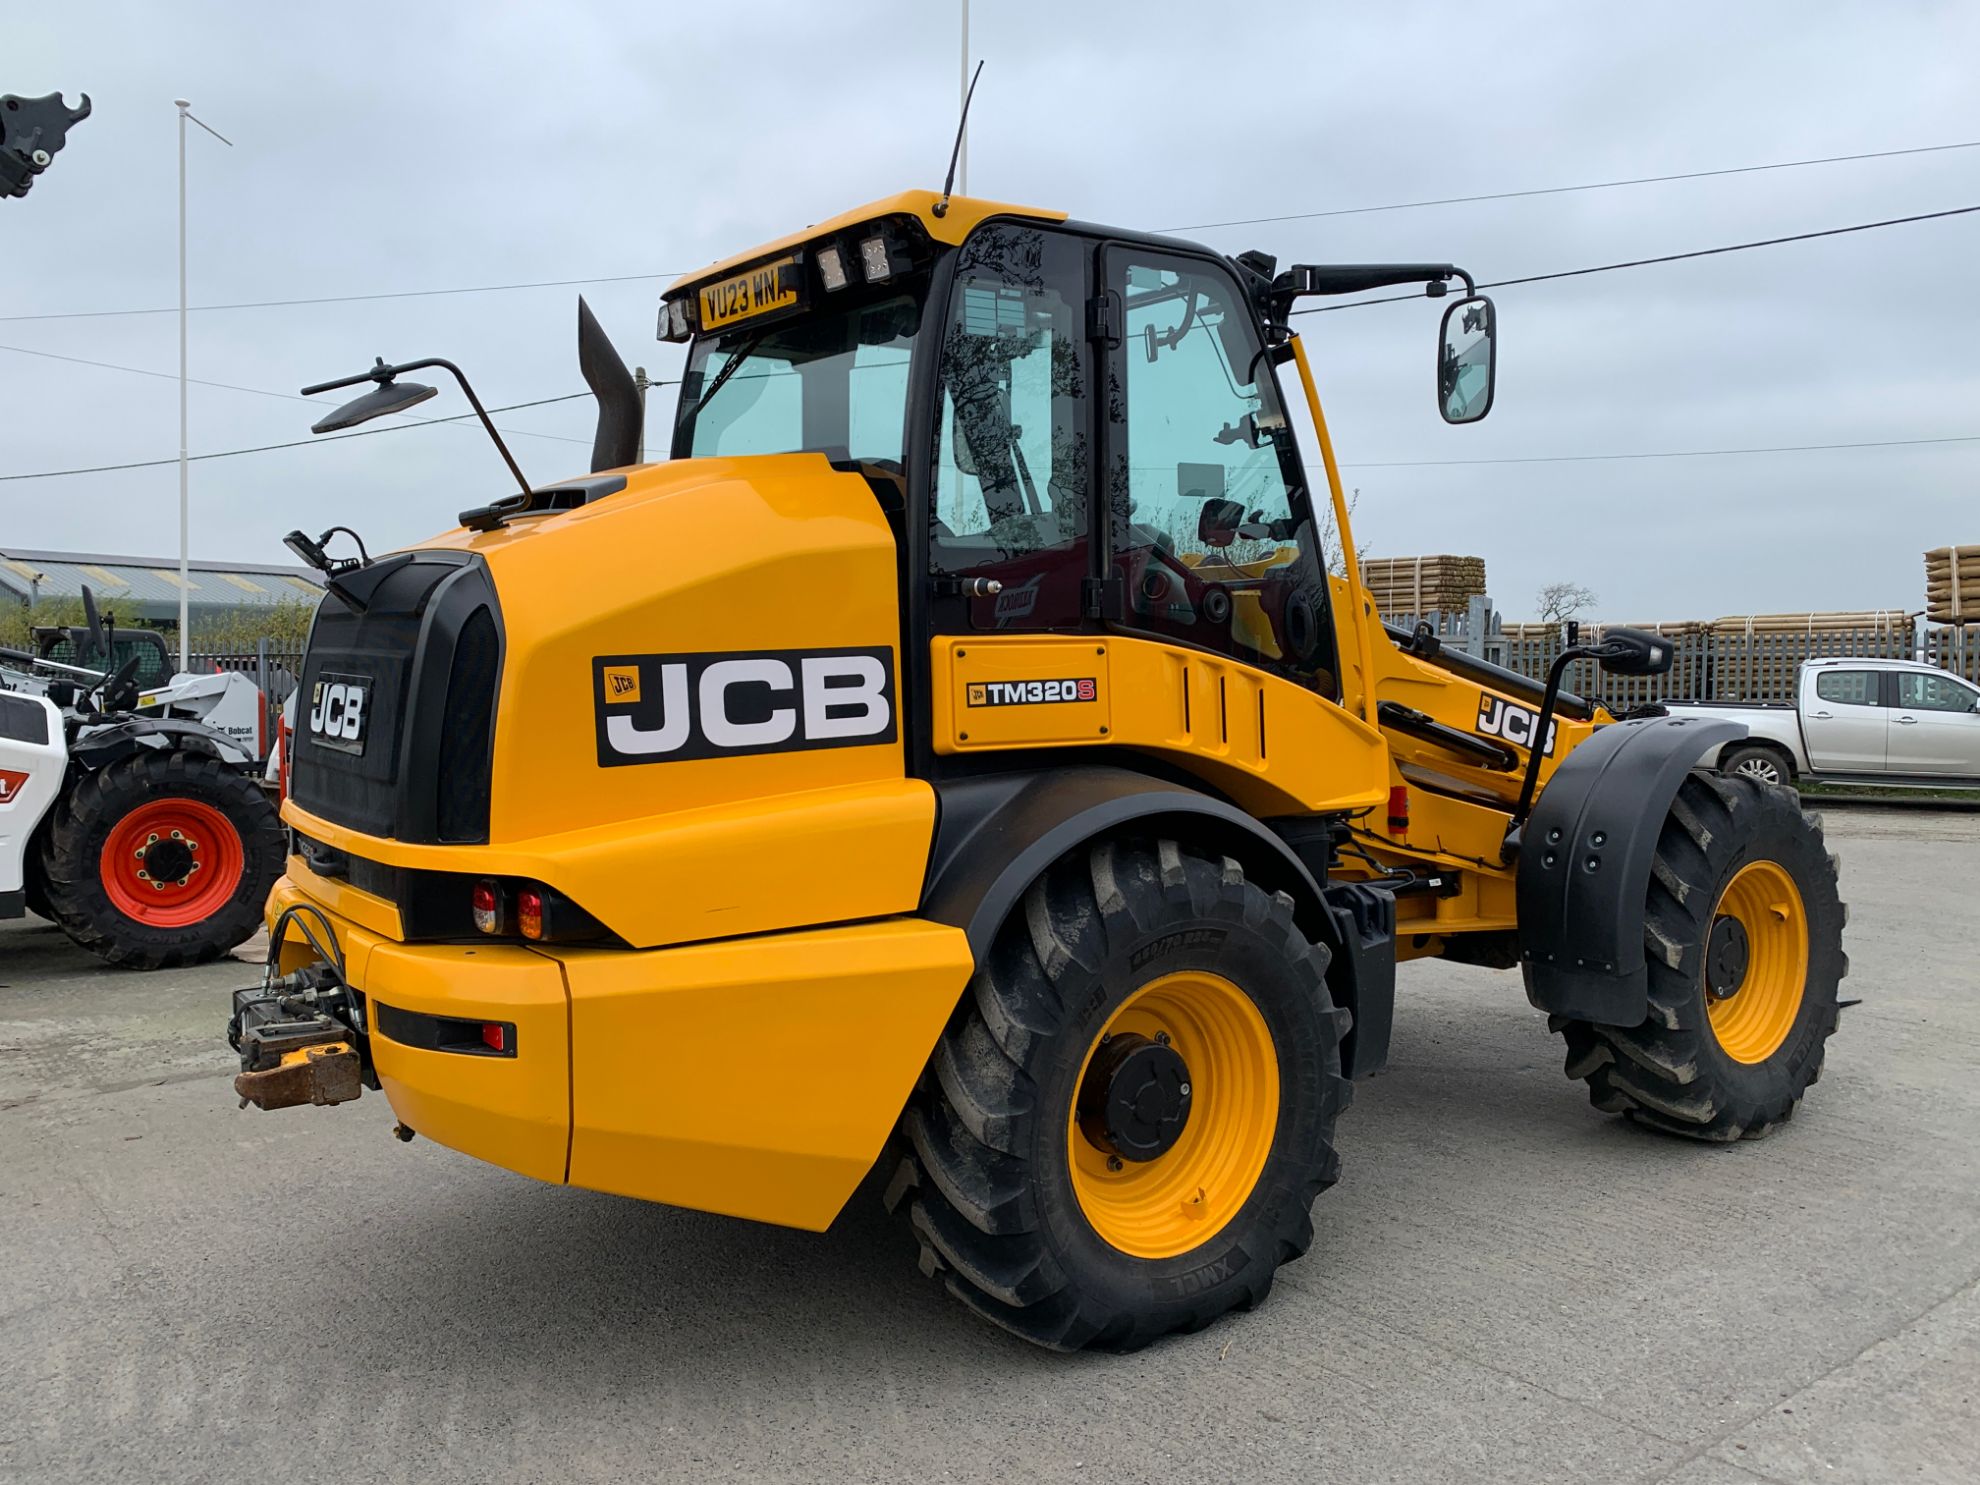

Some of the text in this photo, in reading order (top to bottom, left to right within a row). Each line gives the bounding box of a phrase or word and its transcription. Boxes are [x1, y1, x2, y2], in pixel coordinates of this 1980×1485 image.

[707, 267, 787, 321] VU23 WN
[613, 676, 634, 693] JCB
[987, 679, 1095, 704] TM320S
[310, 682, 363, 740] JCB
[607, 655, 890, 755] JCB
[228, 726, 253, 735] Bobcat
